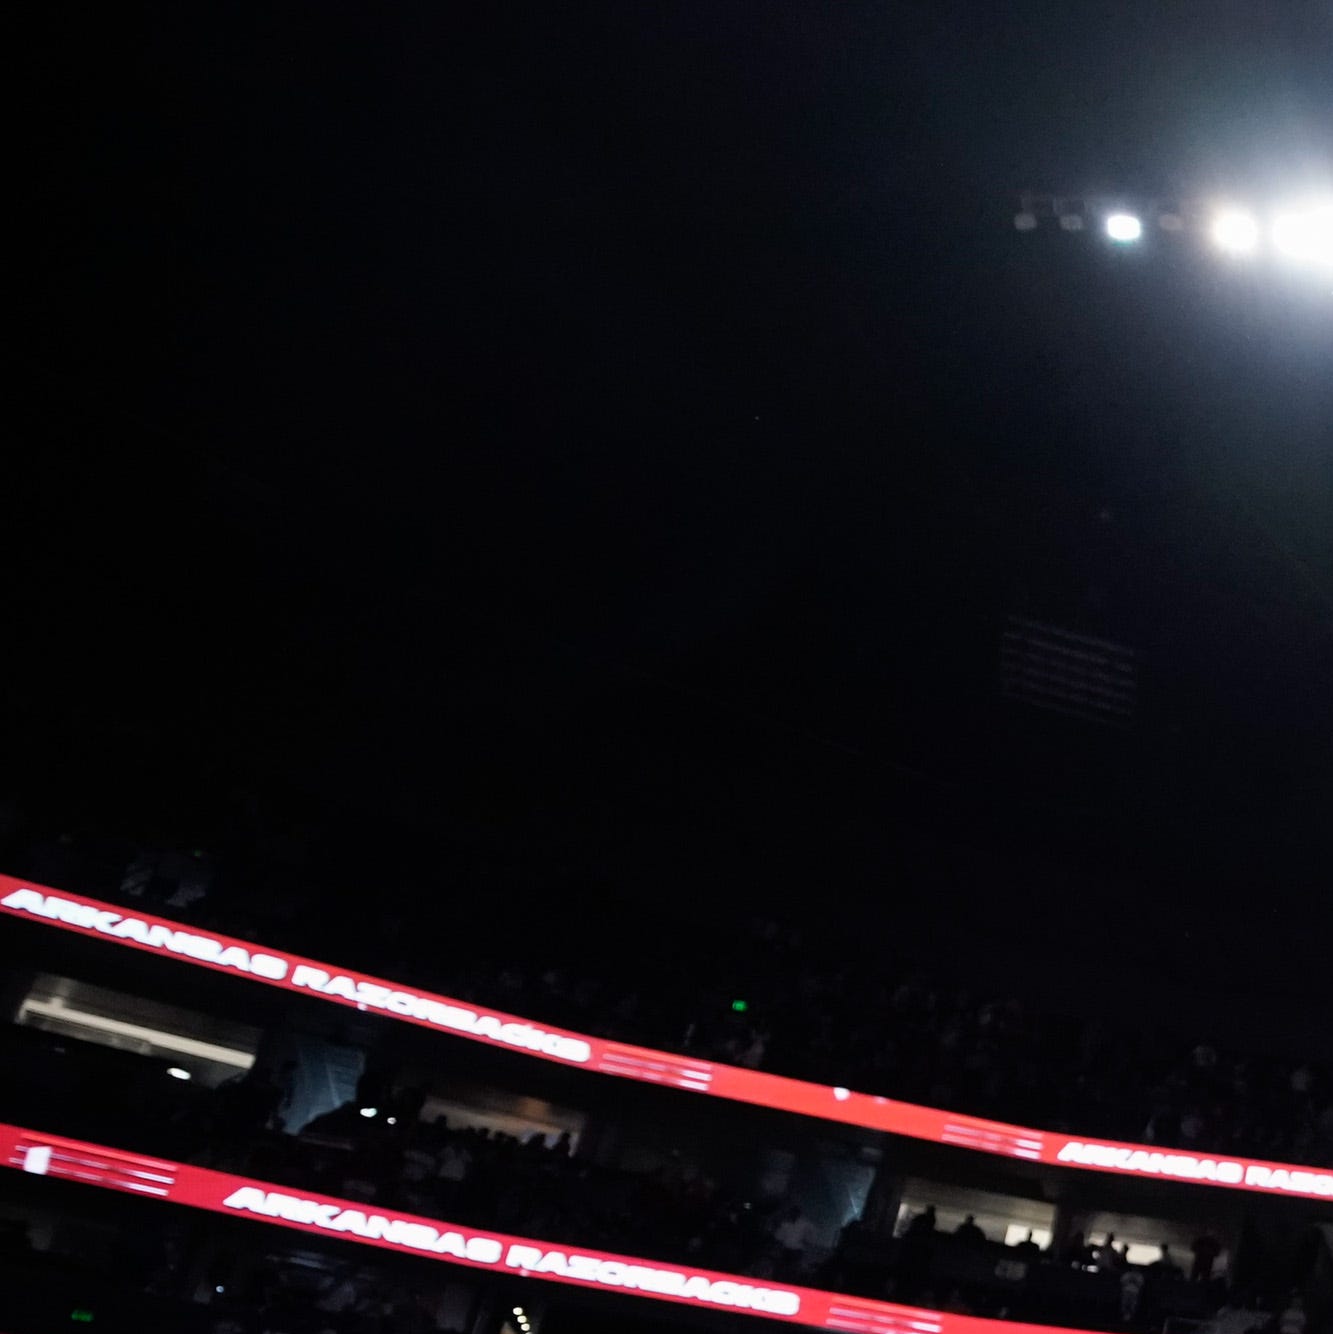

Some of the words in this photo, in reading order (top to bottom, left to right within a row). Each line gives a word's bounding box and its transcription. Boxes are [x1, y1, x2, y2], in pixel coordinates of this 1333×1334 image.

[1, 888, 289, 981] ARKANSAS
[291, 964, 592, 1063] RAZORBACKS
[223, 1187, 502, 1263] ARKANSAS
[505, 1245, 801, 1318] RAZORBACKS
